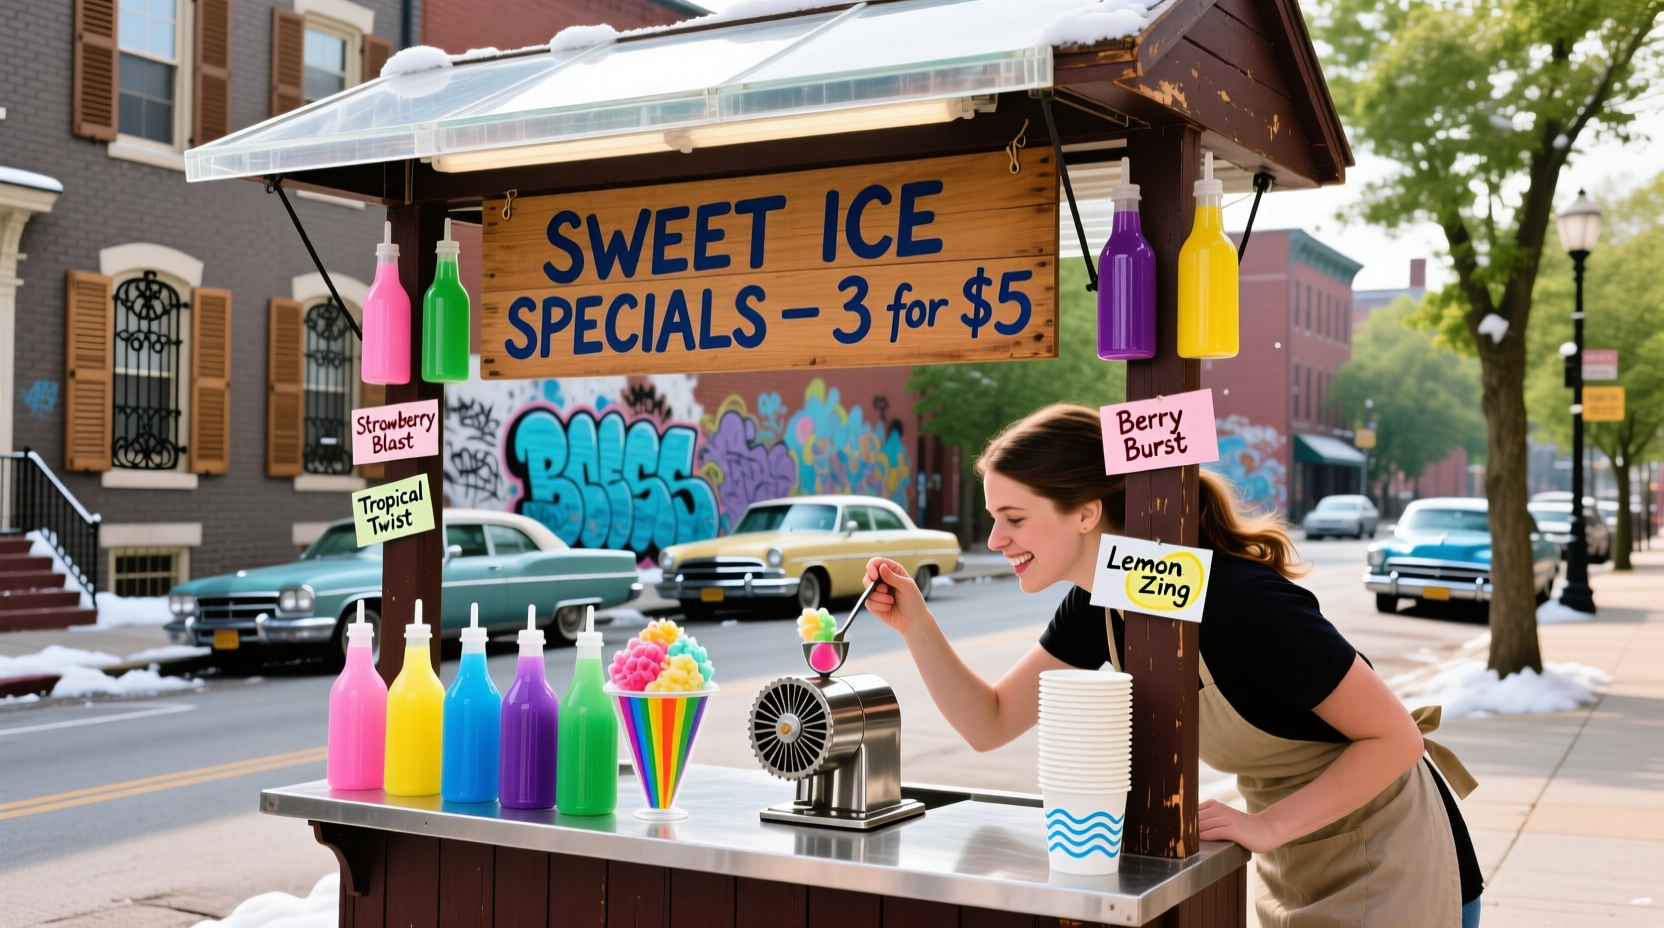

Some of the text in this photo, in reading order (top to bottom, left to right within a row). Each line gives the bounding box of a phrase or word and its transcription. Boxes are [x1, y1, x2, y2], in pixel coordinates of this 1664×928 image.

[543, 180, 943, 284] SWEET ICE
[504, 284, 767, 360] SPECIALS
[832, 275, 872, 344] 3
[886, 282, 949, 344] for
[960, 267, 1033, 339] $5
[1115, 409, 1183, 435] Berry
[372, 432, 415, 454] Blast
[1123, 431, 1188, 462] Burst
[357, 480, 423, 515] Tropical
[366, 508, 413, 536] Twist
[1106, 545, 1182, 578] Lemon
[1138, 575, 1191, 608] Zing
